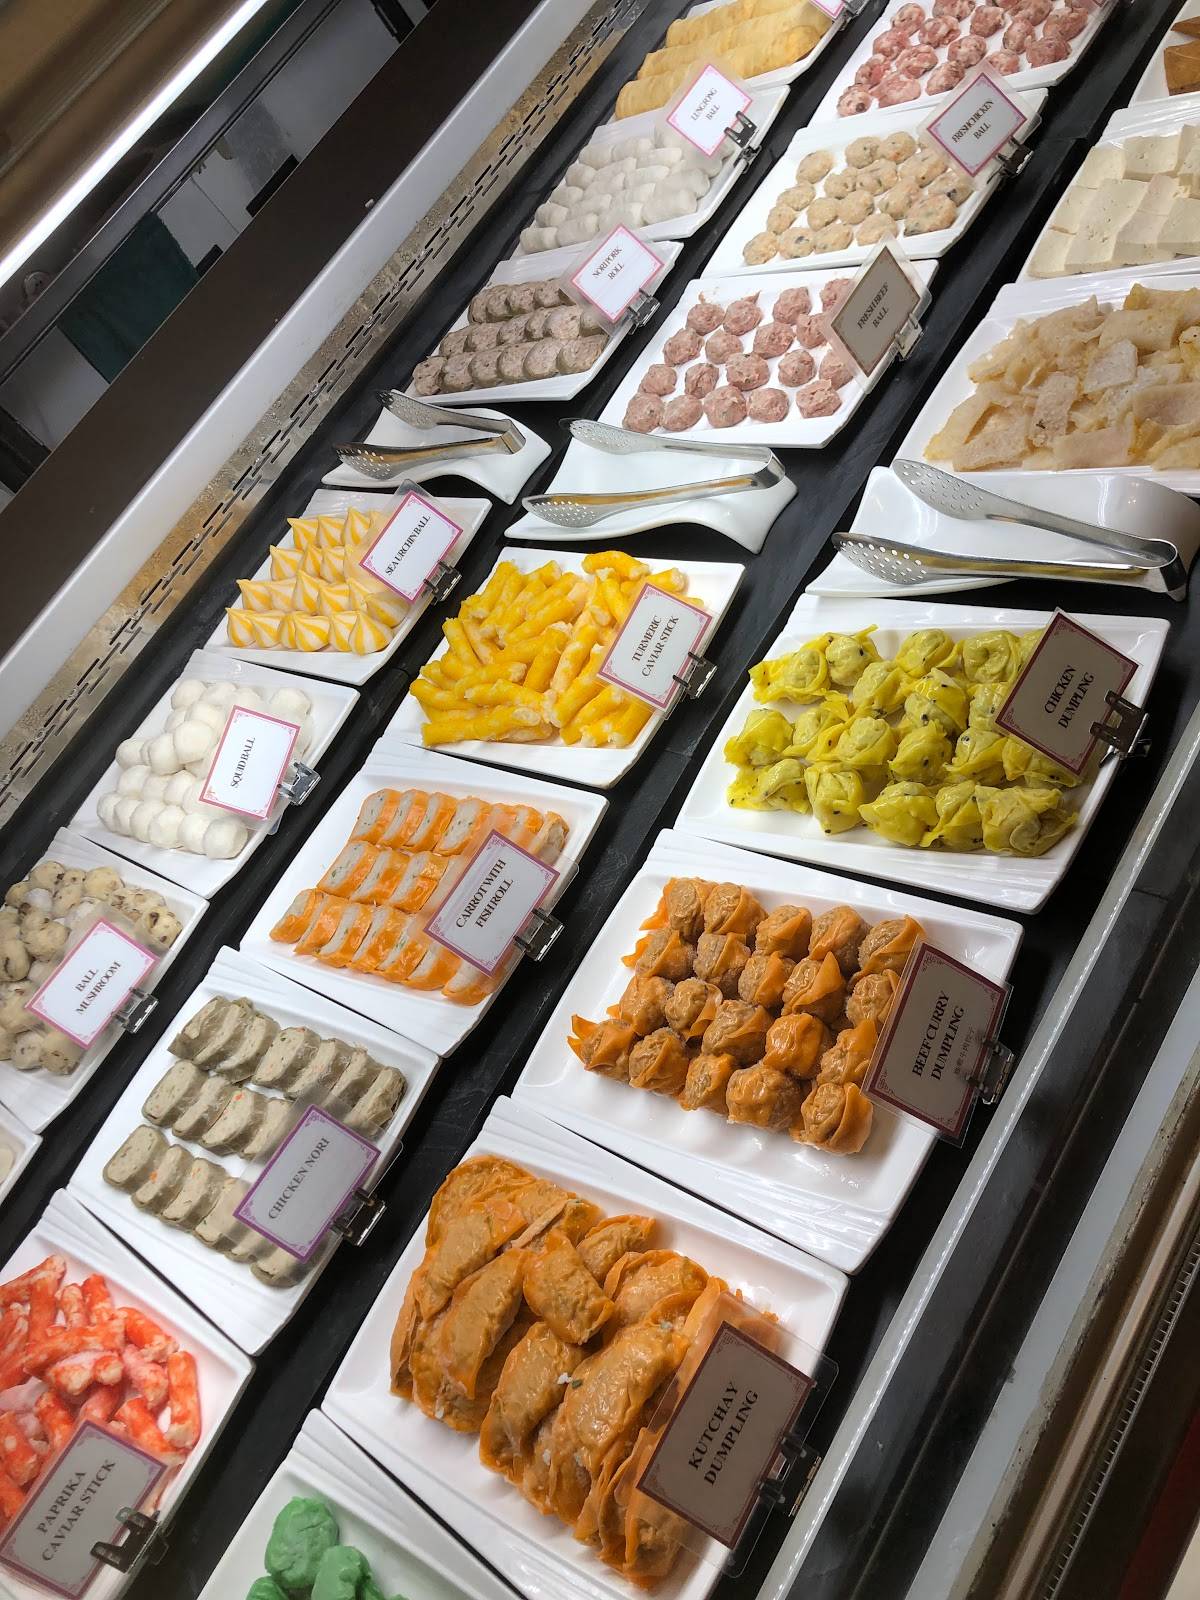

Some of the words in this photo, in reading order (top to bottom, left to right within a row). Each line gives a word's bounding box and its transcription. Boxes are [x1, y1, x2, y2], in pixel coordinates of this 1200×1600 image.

[705, 103, 721, 121] BALL
[972, 120, 992, 140] BALL
[607, 261, 625, 280] ROLL
[871, 305, 890, 329] BALL
[384, 559, 400, 577] SEA
[394, 530, 419, 562] URCHIN
[413, 513, 431, 535] BALL
[631, 614, 663, 662] TURMERIC
[640, 641, 665, 678] CAVIAR
[659, 615, 679, 643] STICK
[1042, 664, 1077, 715] CHICKEN
[1056, 671, 1096, 729] DUMPLING
[229, 759, 248, 789] SQUID
[240, 737, 256, 761] BALL
[454, 884, 488, 929] CARROT
[481, 858, 507, 888] WITH
[474, 901, 497, 928] FISH
[489, 877, 514, 907] ROLL
[75, 968, 99, 993] BALL
[75, 960, 122, 1015] MUSHROOM
[911, 1038, 933, 1077] BEEF
[924, 989, 951, 1042] CURRY
[930, 1004, 966, 1081] DUMPLING
[267, 1166, 310, 1221] CHICKEN
[303, 1136, 331, 1169] NORI
[687, 1381, 739, 1470] KUTCHAY
[702, 1389, 760, 1487] DUMPLING
[36, 1469, 87, 1535] PAPRIKA
[40, 1503, 85, 1563] CAVIAR
[79, 1458, 116, 1505] STICK
